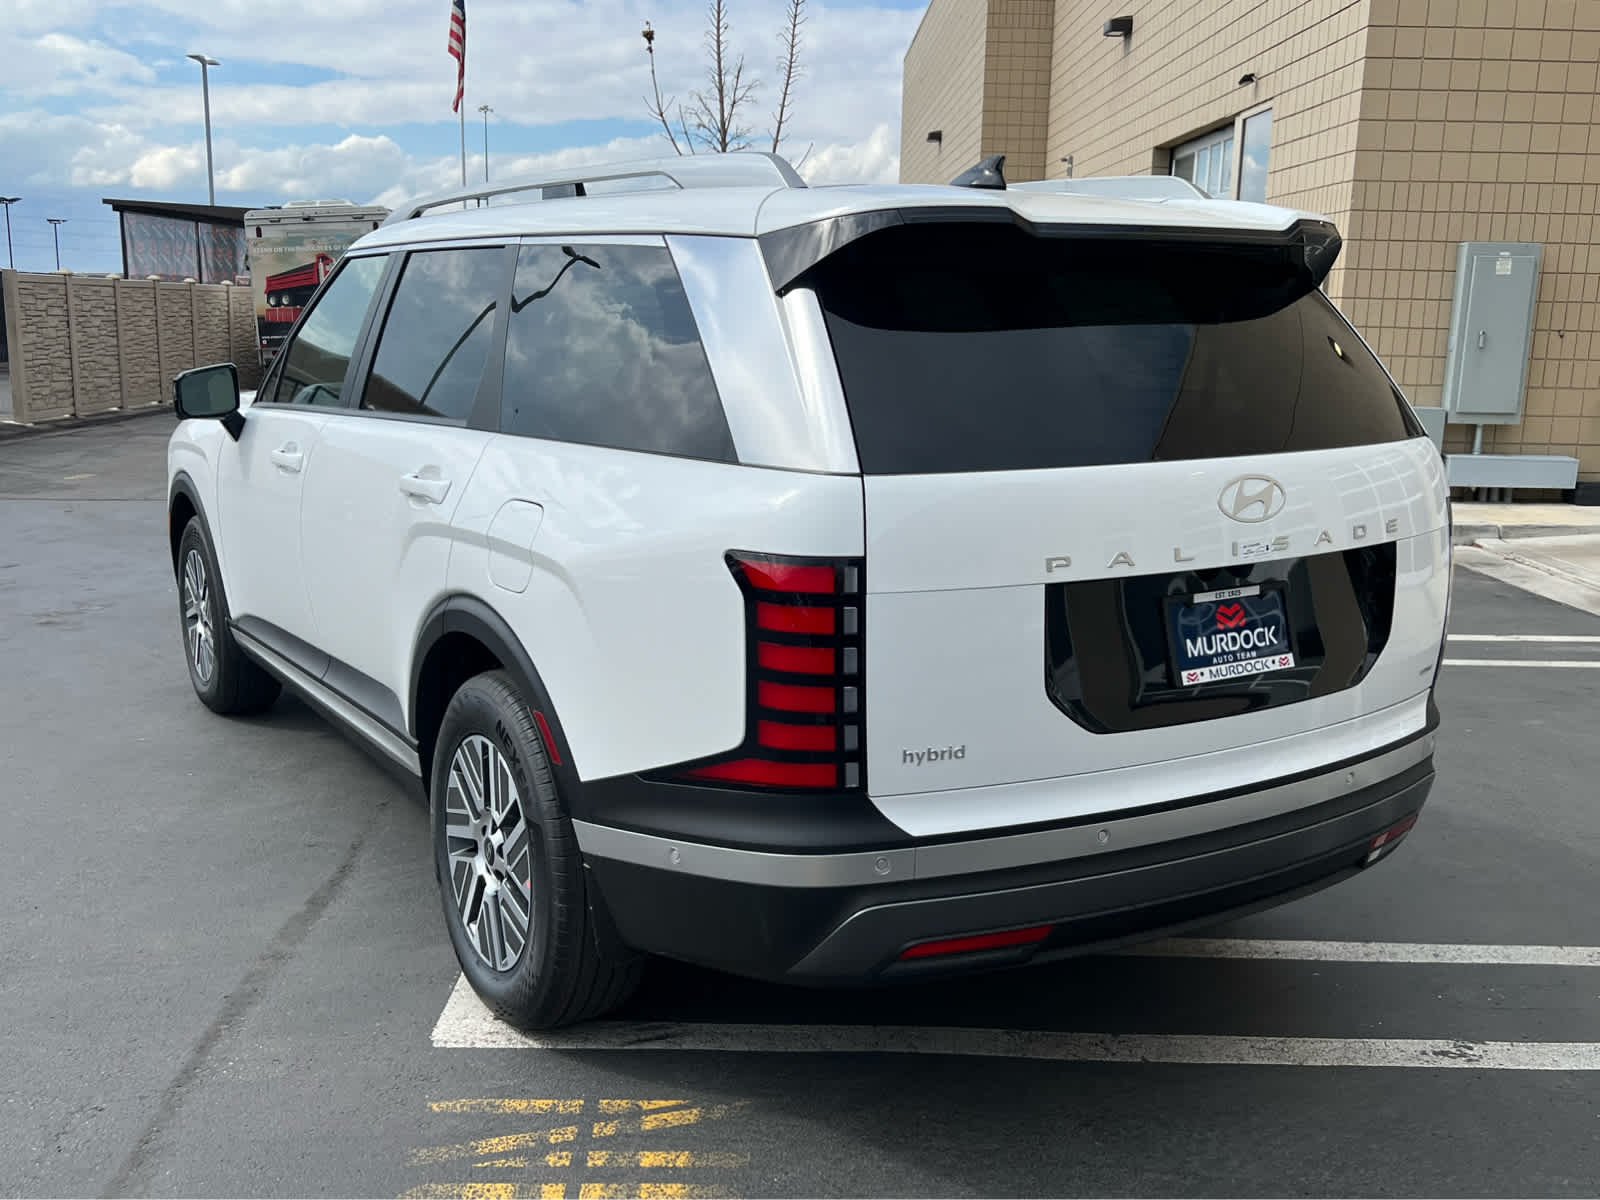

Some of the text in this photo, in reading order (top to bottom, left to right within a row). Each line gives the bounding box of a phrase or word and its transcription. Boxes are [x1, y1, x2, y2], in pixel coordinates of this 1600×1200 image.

[1045, 518, 1399, 573] PALISADE
[1186, 625, 1278, 658] MURDOCK
[1209, 660, 1270, 679] MURDOCK
[1212, 651, 1257, 665] AUTO TEAM
[902, 744, 966, 767] hybrid
